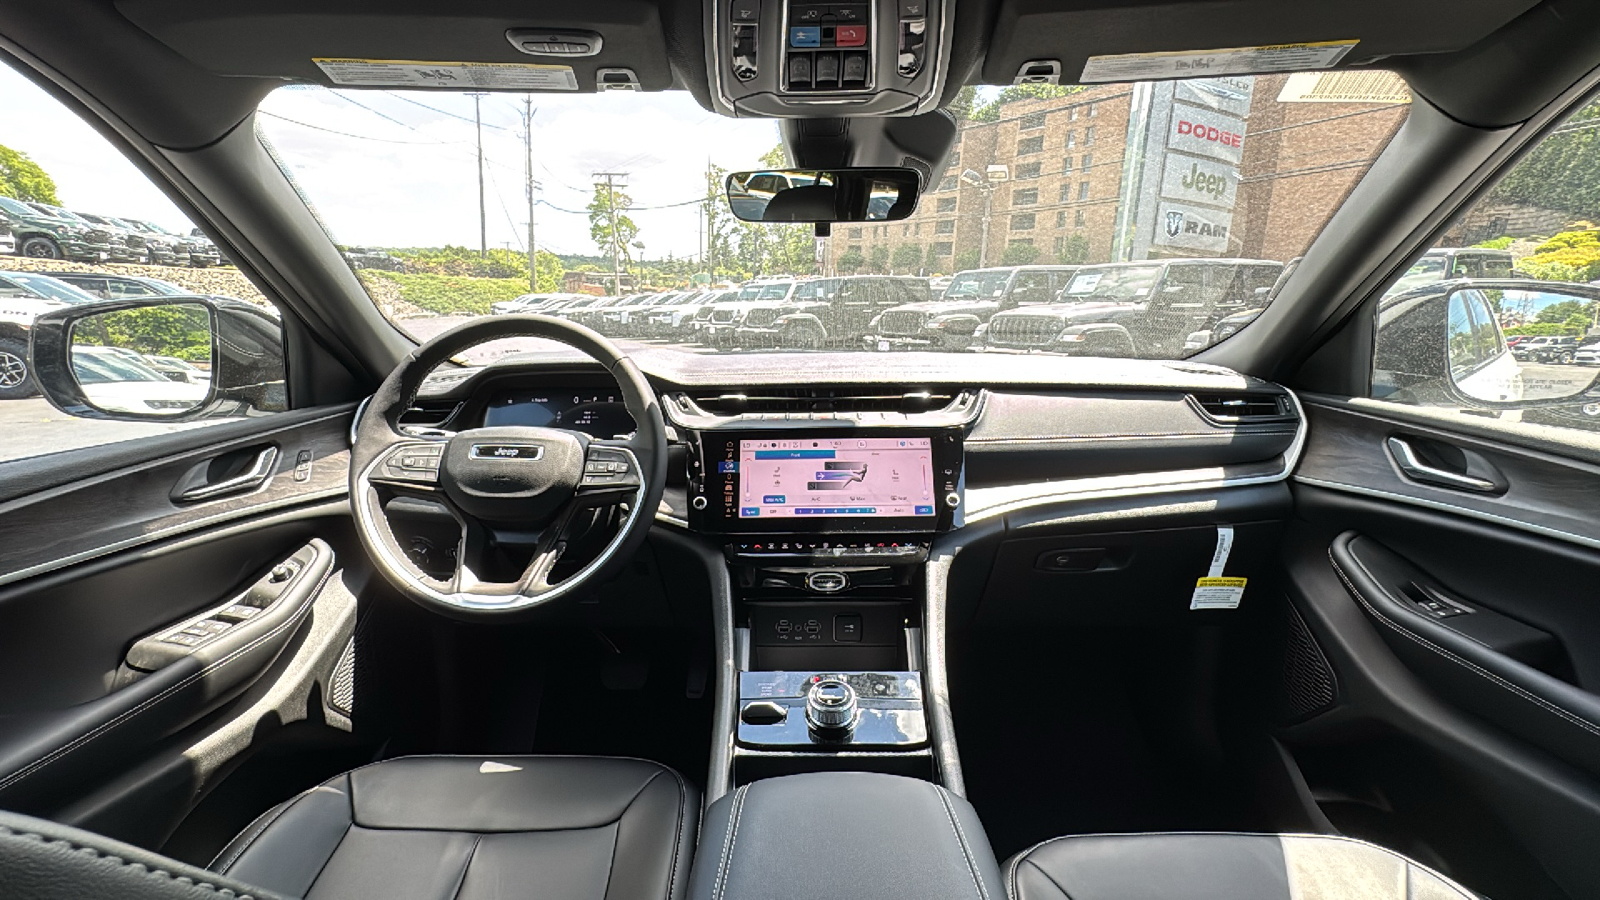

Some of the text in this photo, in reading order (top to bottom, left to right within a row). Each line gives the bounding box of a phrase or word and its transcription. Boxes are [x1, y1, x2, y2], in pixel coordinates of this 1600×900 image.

[1217, 77, 1249, 91] SLER
[1177, 119, 1242, 148] DODGE
[1181, 162, 1227, 200] Jeep
[1184, 220, 1228, 239] RAM
[494, 447, 519, 457] Jeep
